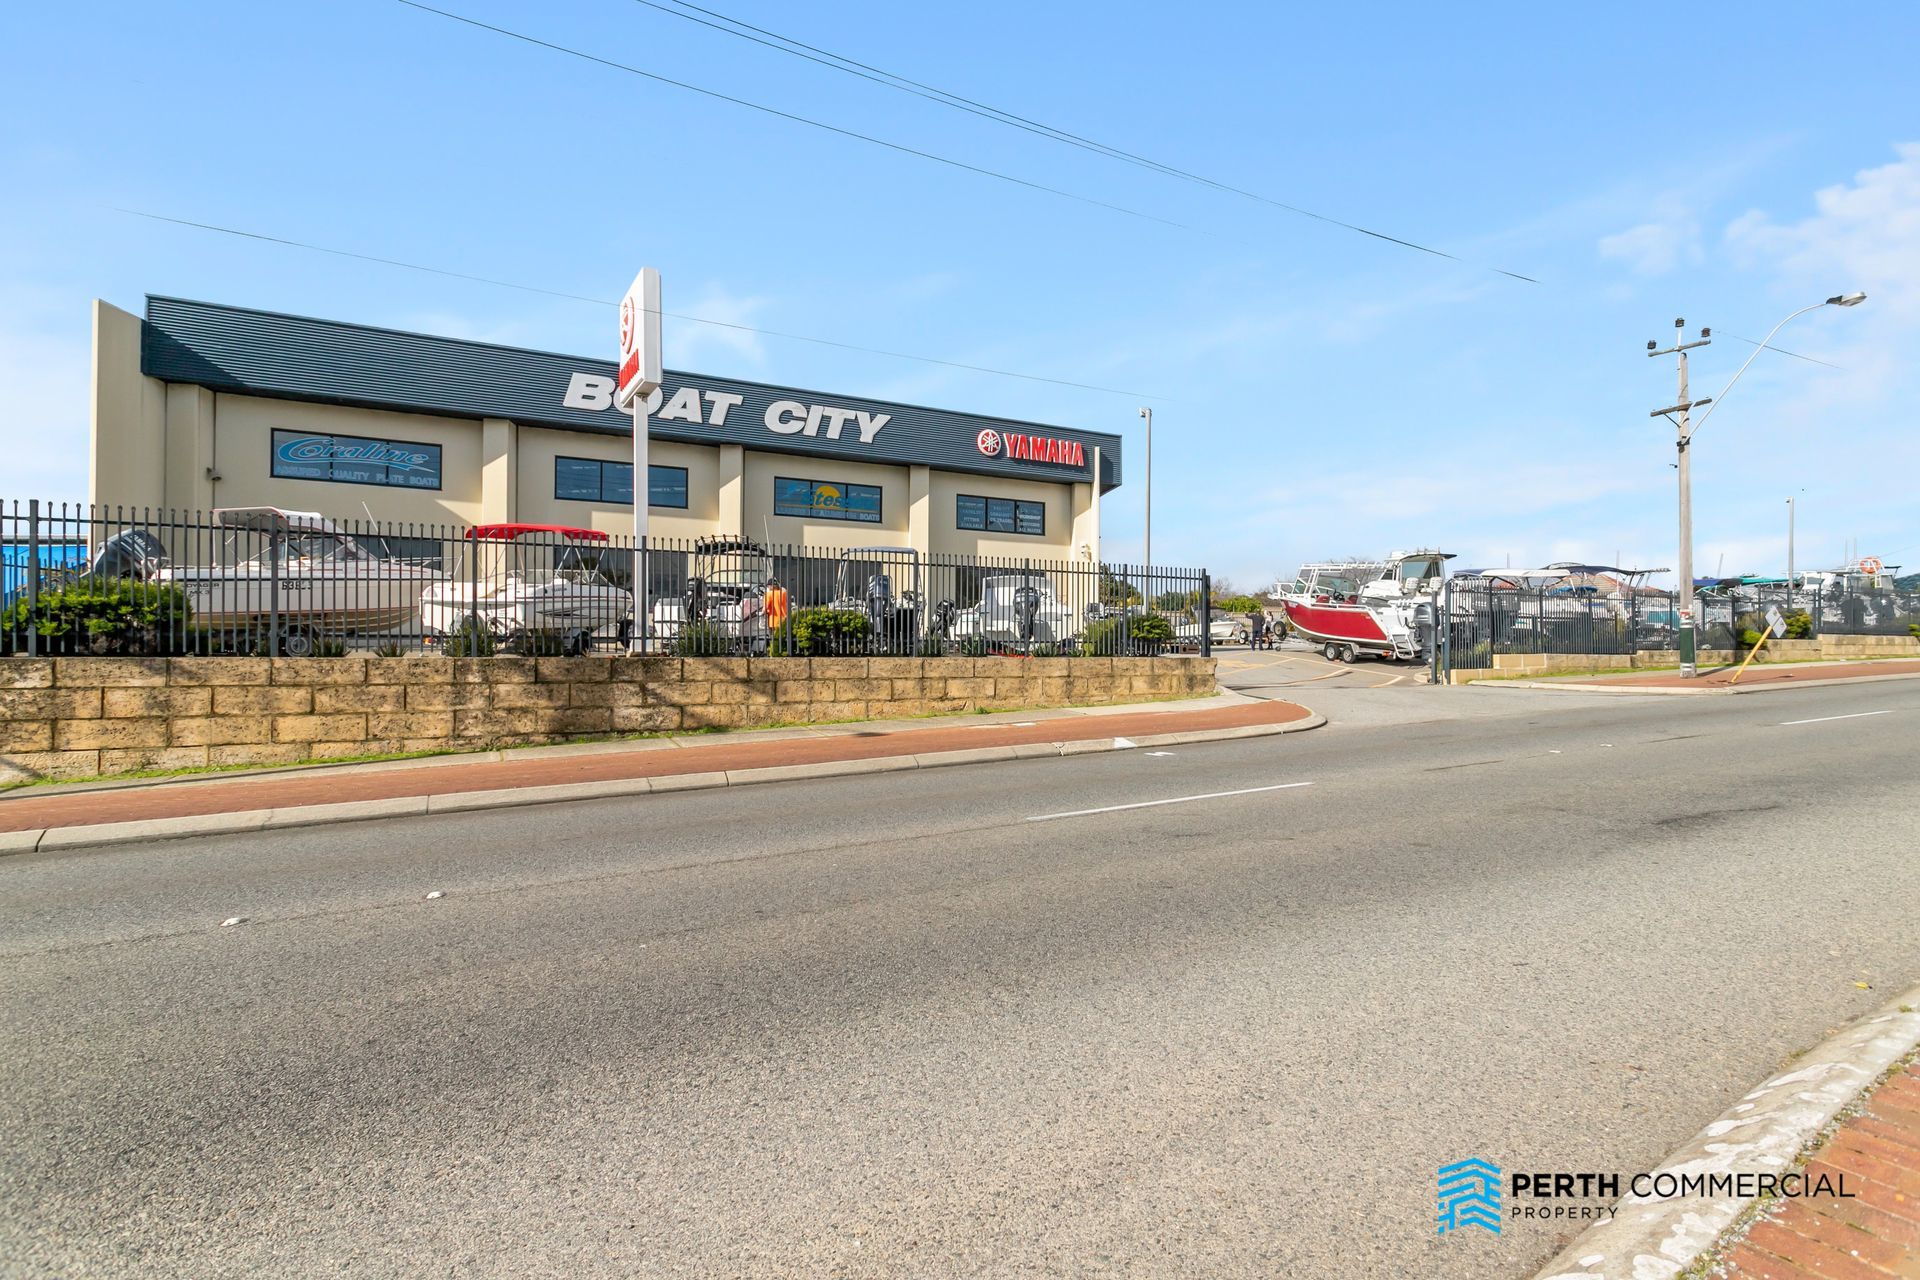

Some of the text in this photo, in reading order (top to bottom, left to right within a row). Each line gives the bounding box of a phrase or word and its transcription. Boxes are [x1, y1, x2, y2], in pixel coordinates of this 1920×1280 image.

[764, 400, 892, 444] CITY
[278, 437, 432, 468] Coraline
[1003, 433, 1084, 466] YAMAHA
[329, 469, 370, 480] QUALITY
[409, 476, 438, 487] BOATS
